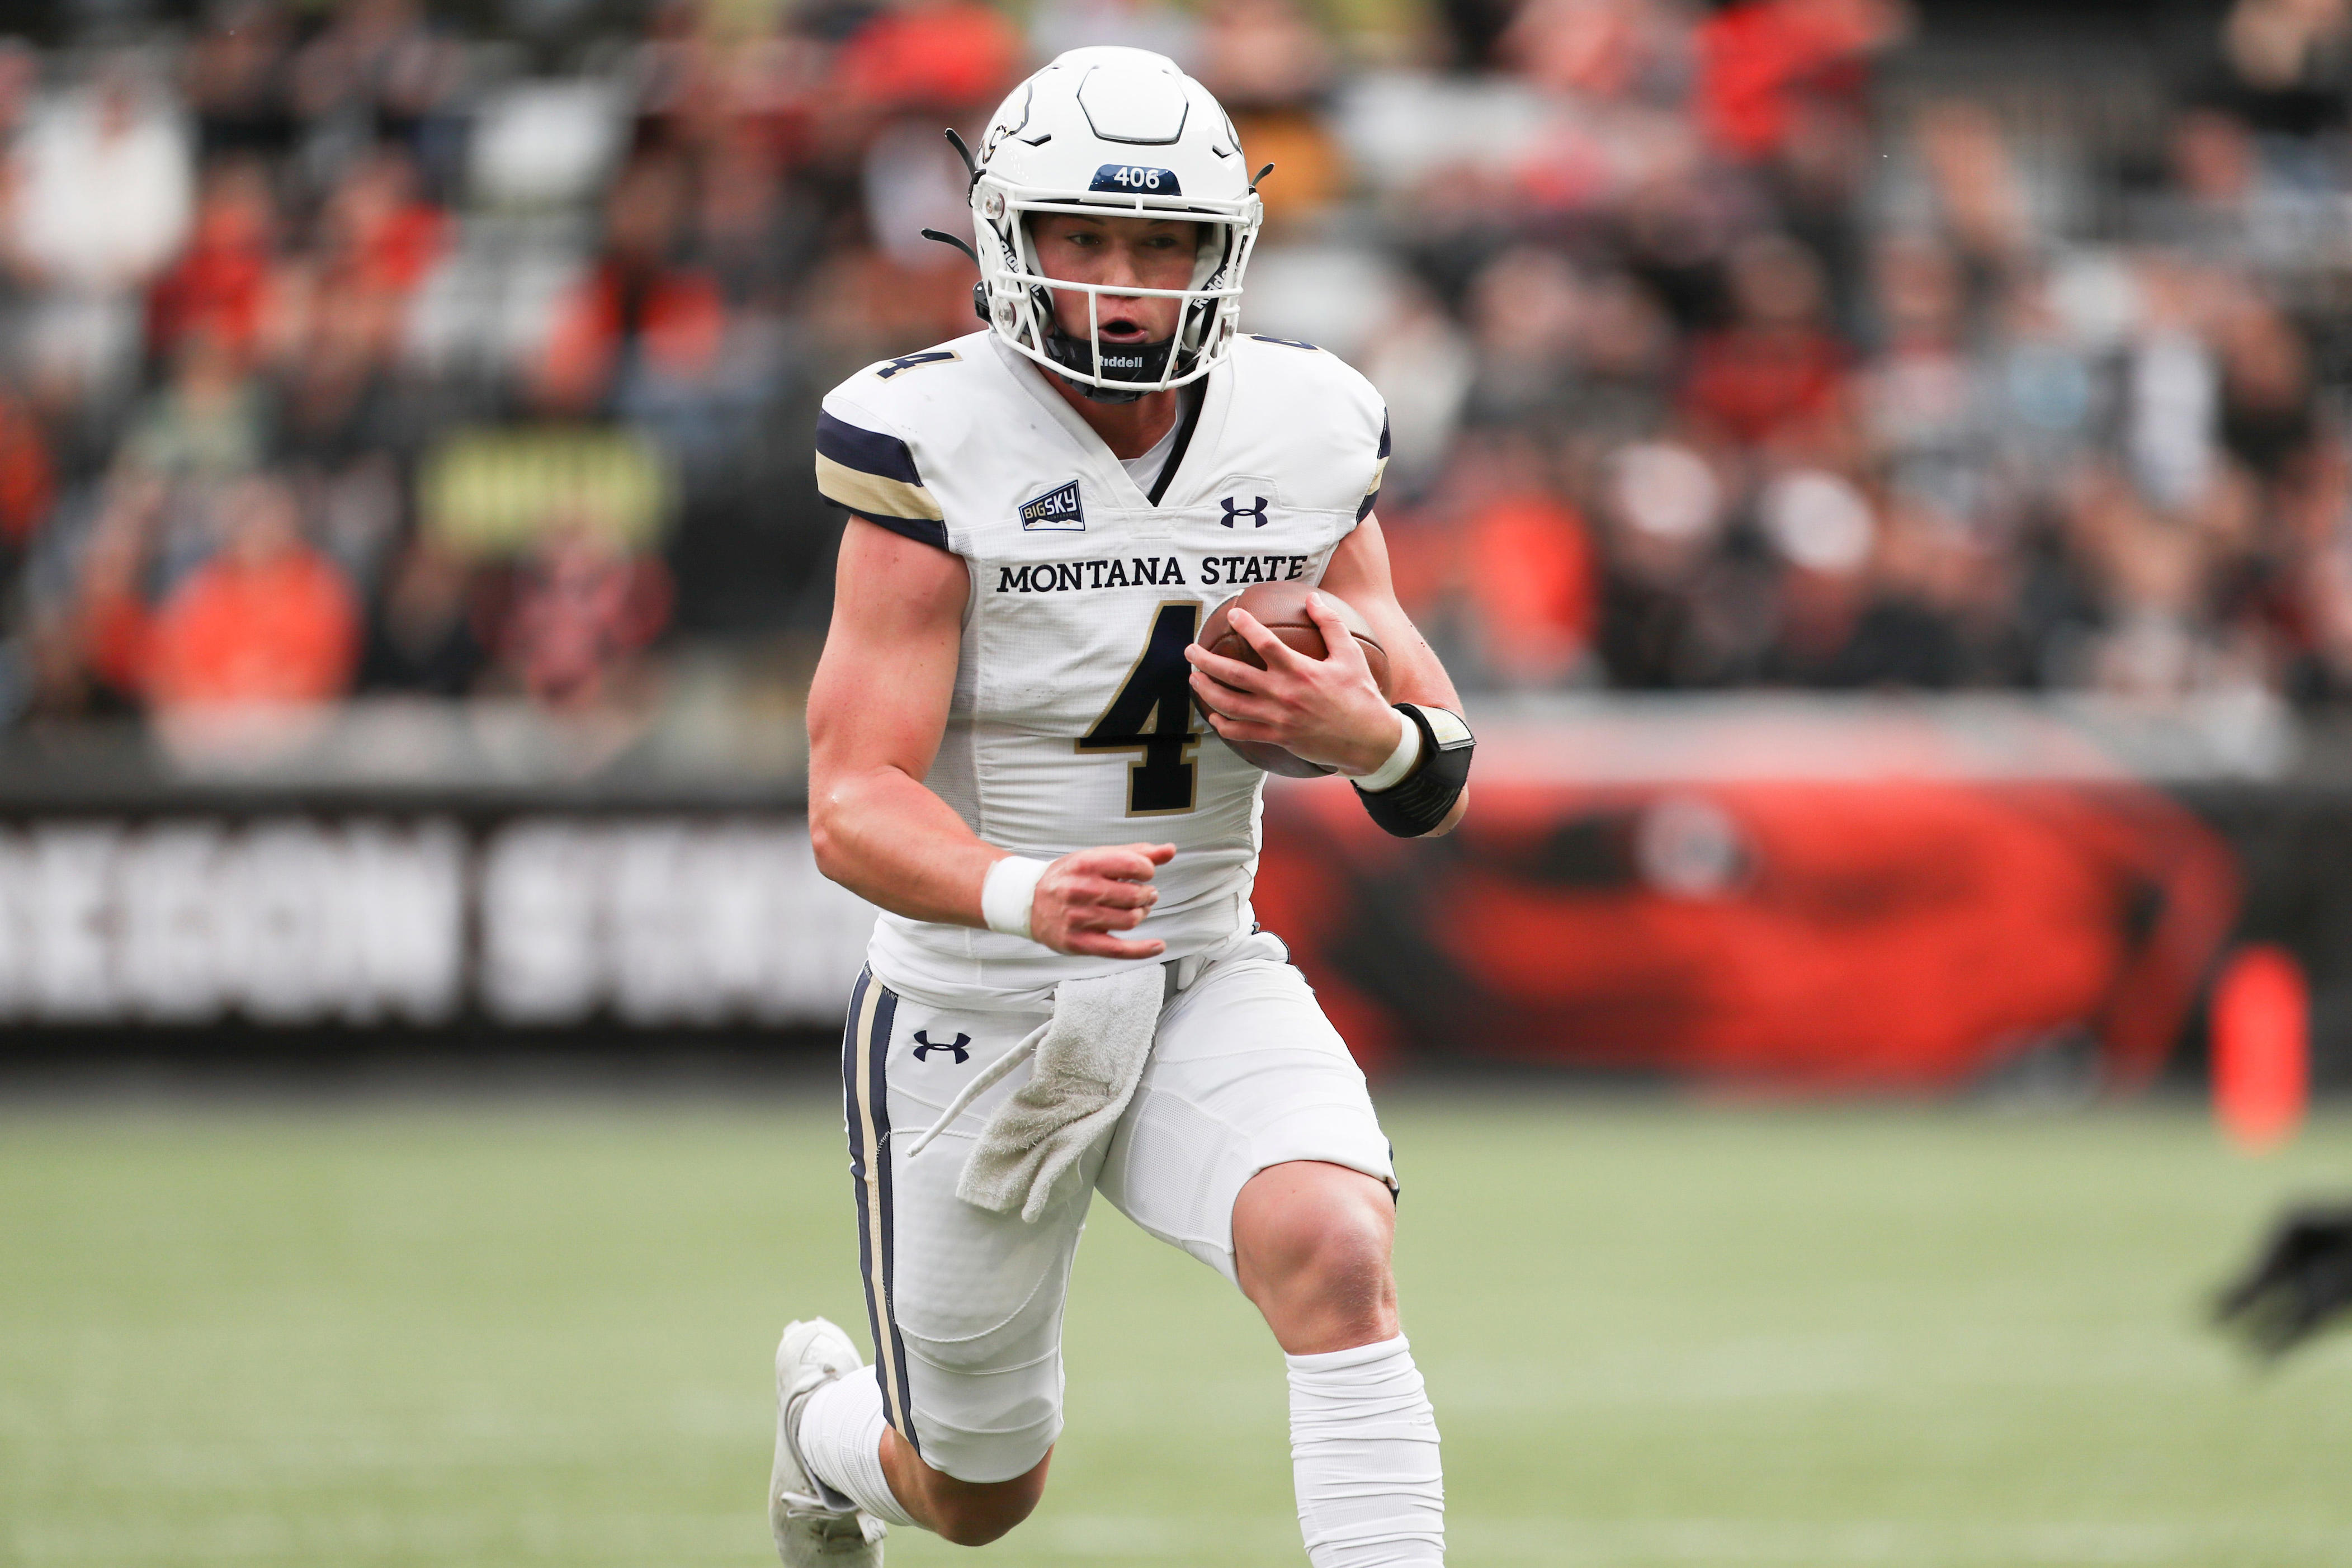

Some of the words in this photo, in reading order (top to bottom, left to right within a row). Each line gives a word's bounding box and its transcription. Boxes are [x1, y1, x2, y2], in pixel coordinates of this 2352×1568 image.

[1113, 167, 1160, 190] 406
[996, 556, 1186, 593] MONTANA
[1201, 555, 1309, 586] STATE
[1074, 599, 1205, 818] 4
